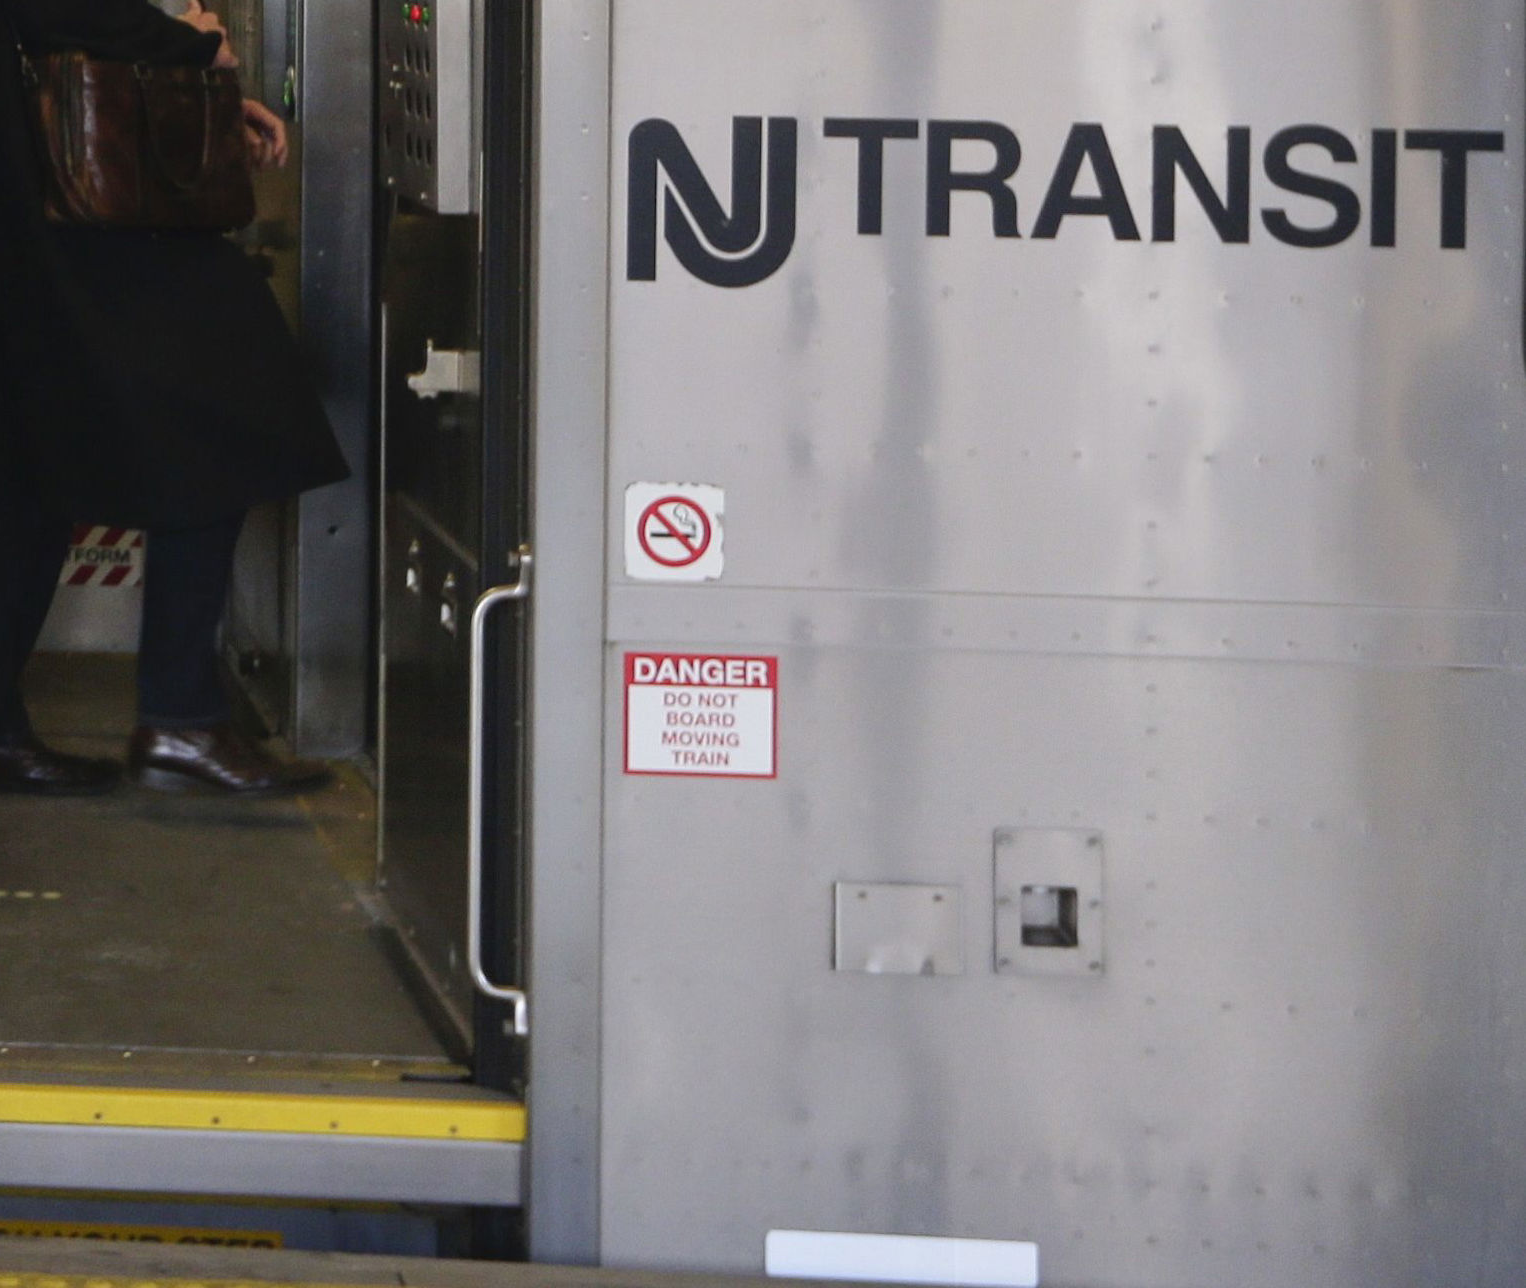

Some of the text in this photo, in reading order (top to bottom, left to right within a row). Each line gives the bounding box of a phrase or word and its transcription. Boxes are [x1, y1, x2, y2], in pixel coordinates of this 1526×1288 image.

[626, 116, 1505, 288] NJ TRANSIT
[633, 656, 768, 686] DANGER
[663, 692, 738, 708] DO NOT
[666, 712, 736, 727] BOARD
[661, 731, 740, 747] MOVING
[672, 750, 730, 765] TRAIN
